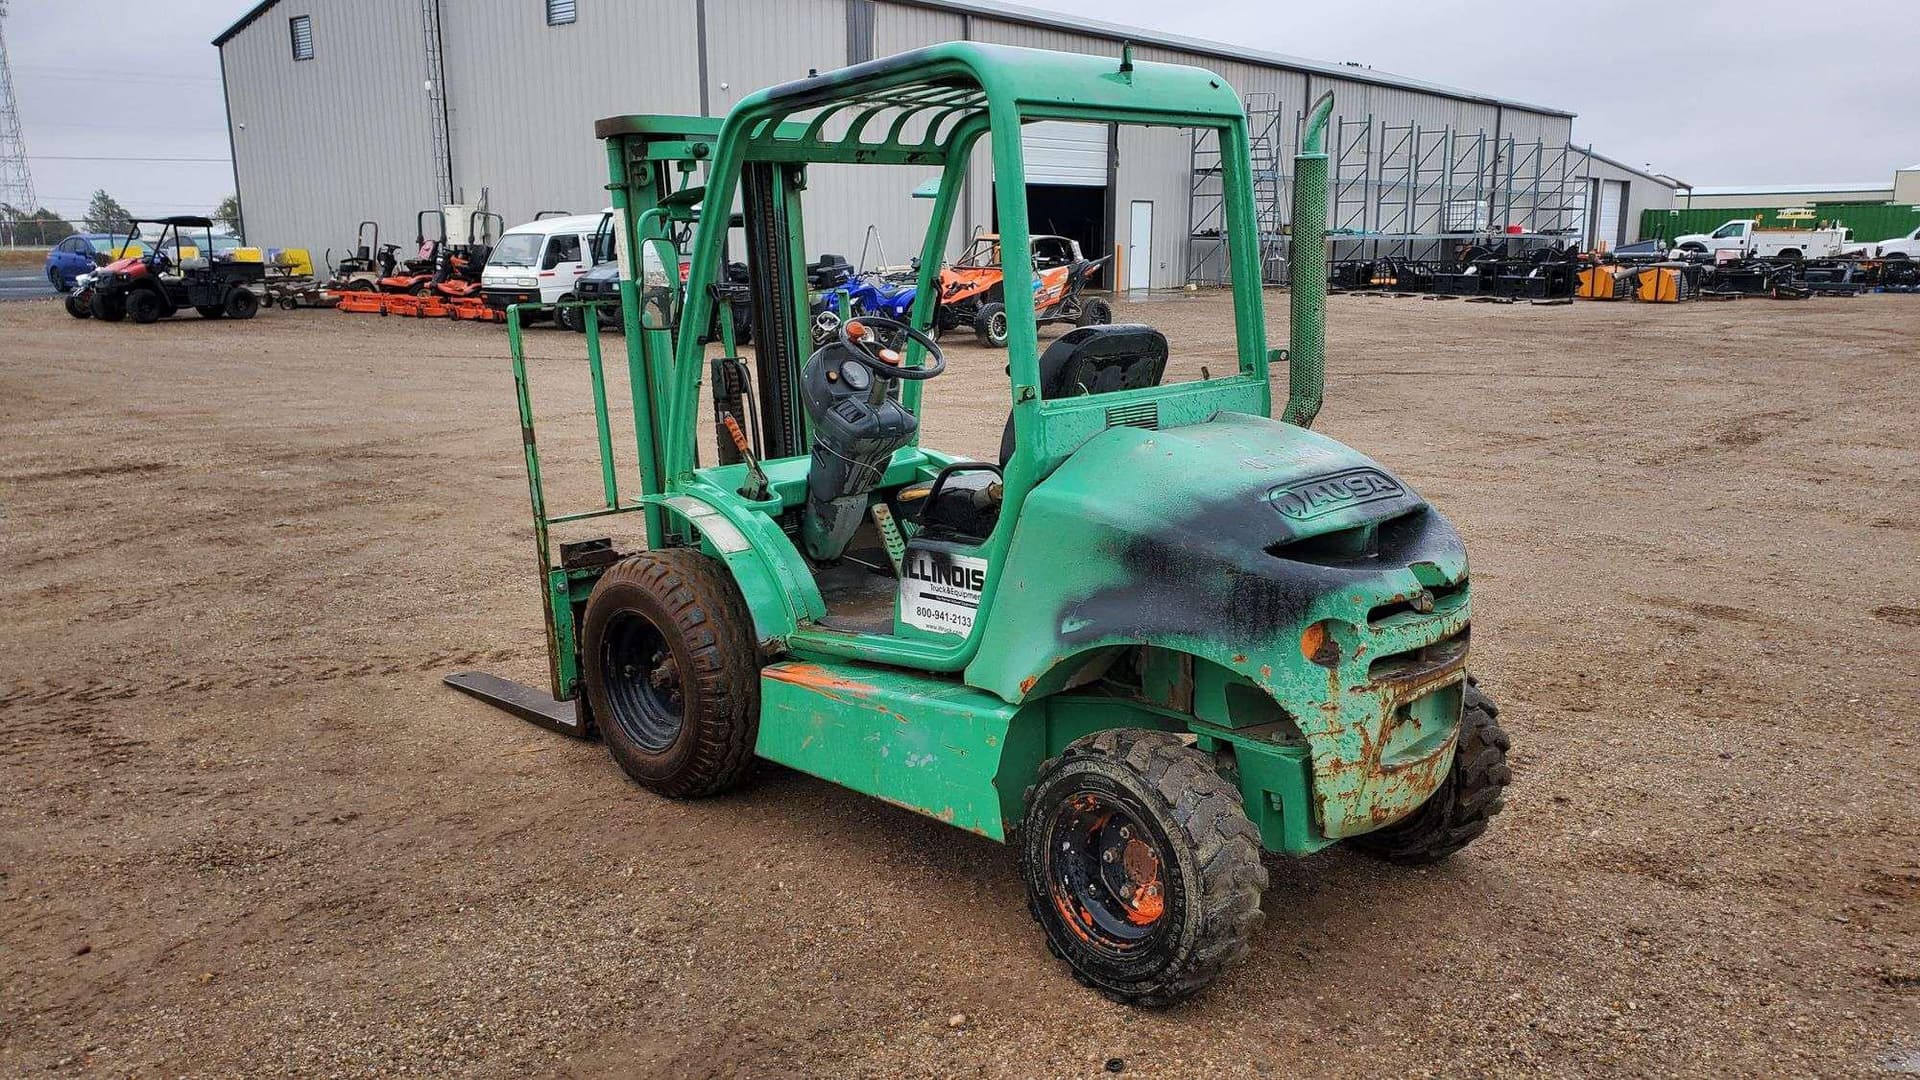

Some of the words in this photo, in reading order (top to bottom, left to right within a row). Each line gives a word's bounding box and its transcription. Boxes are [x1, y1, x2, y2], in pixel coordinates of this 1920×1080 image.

[1304, 475, 1399, 508] AUSA
[902, 558, 985, 592] ILLINOIS
[930, 583, 981, 600] Truck&Equipmen
[916, 606, 972, 628] 800-941-2133
